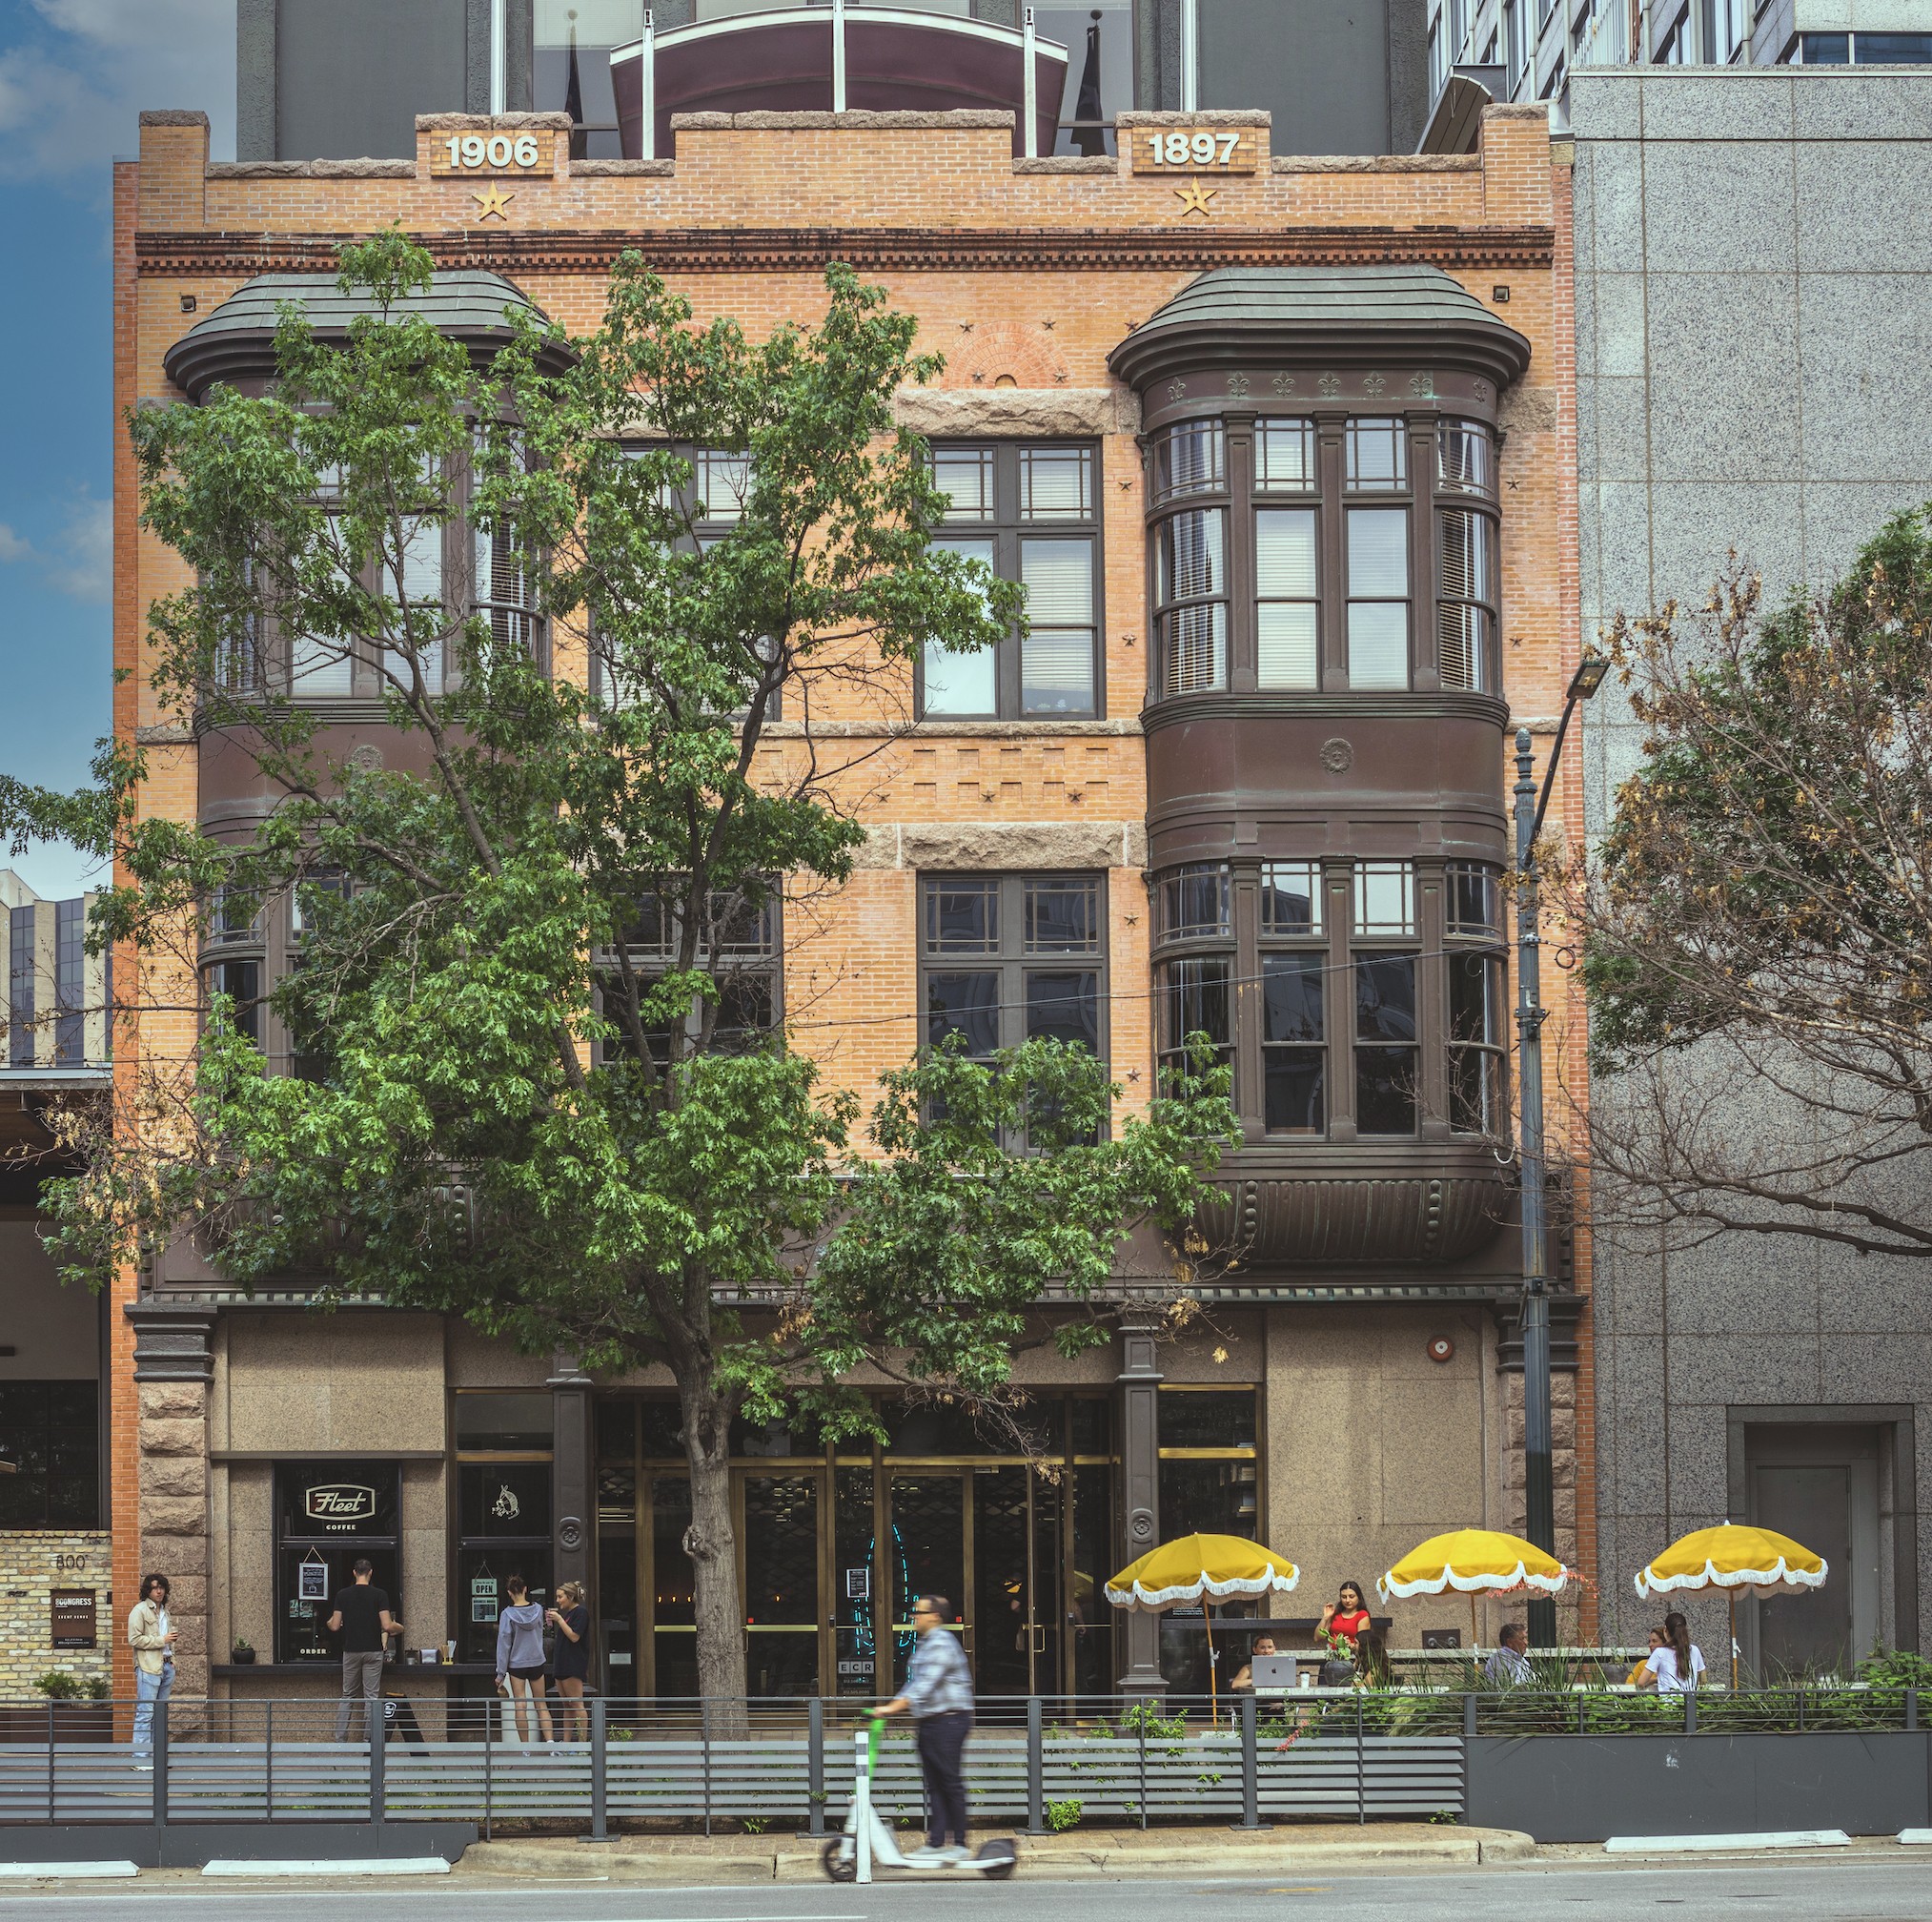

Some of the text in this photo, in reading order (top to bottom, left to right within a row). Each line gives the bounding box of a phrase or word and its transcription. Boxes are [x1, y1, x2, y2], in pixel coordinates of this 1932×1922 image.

[445, 135, 539, 168] 1906
[1149, 133, 1240, 165] 1897
[315, 1492, 367, 1513] Fleet
[56, 1554, 86, 1570] 800
[476, 1585, 493, 1594] OPEN
